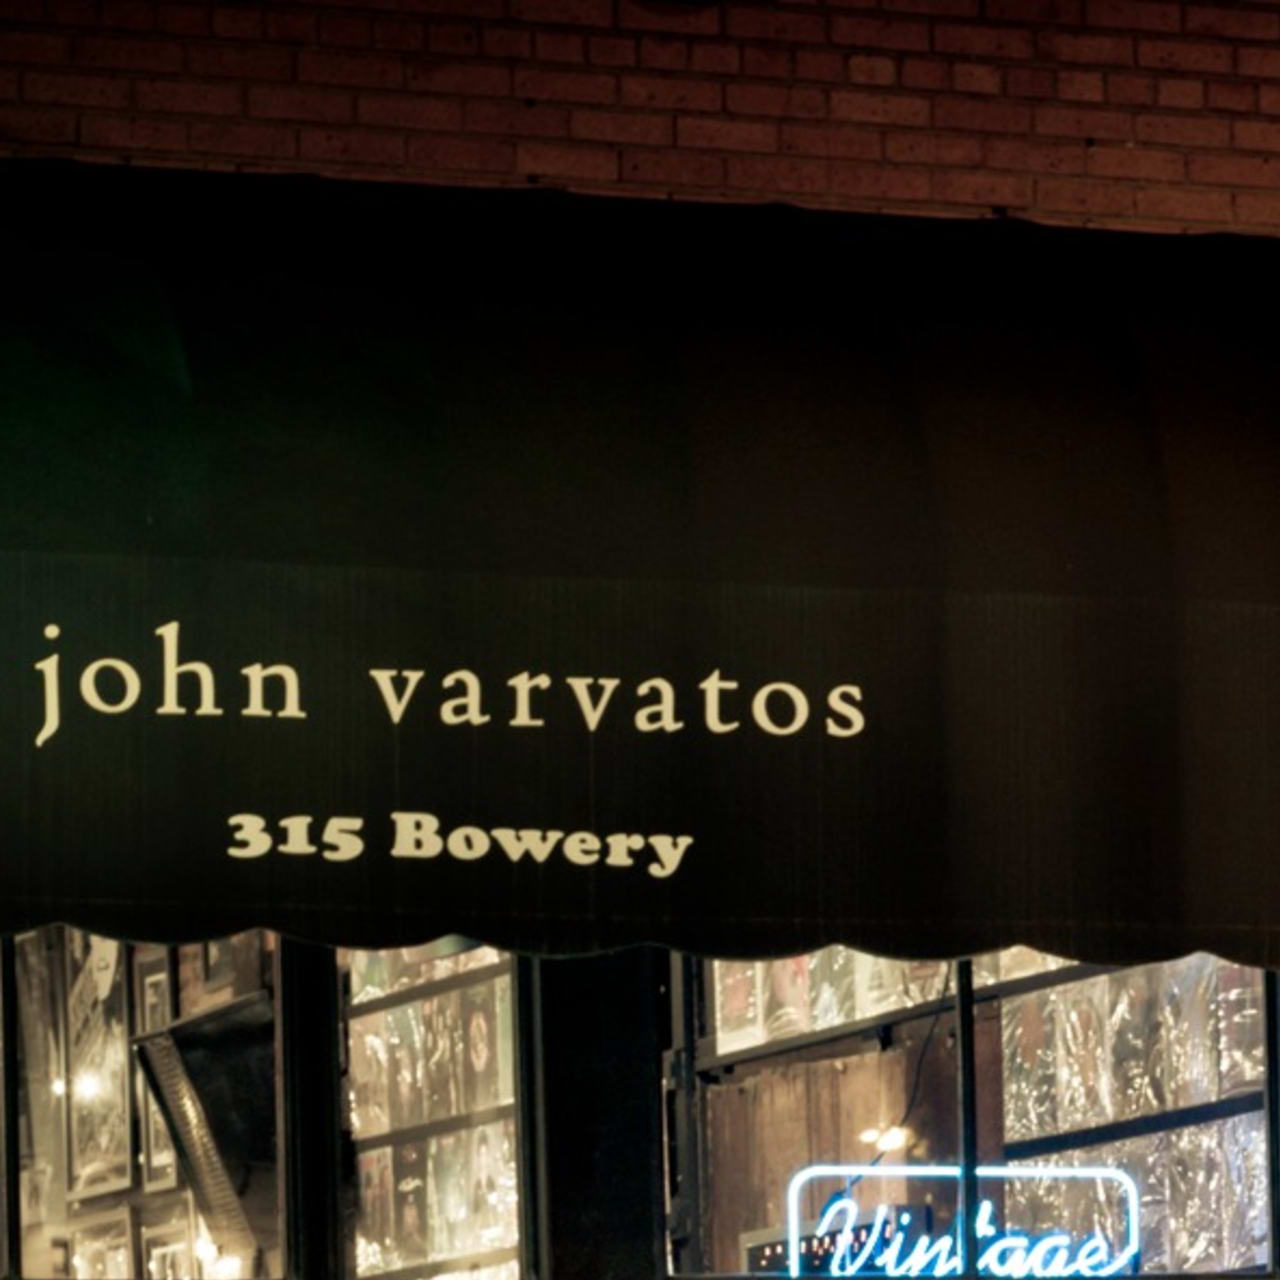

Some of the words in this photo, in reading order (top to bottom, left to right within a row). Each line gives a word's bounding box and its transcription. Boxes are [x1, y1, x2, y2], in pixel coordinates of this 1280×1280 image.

[33, 620, 307, 748] john
[369, 667, 867, 738] varvatos
[225, 812, 366, 863] 315
[391, 810, 695, 880] Bowery
